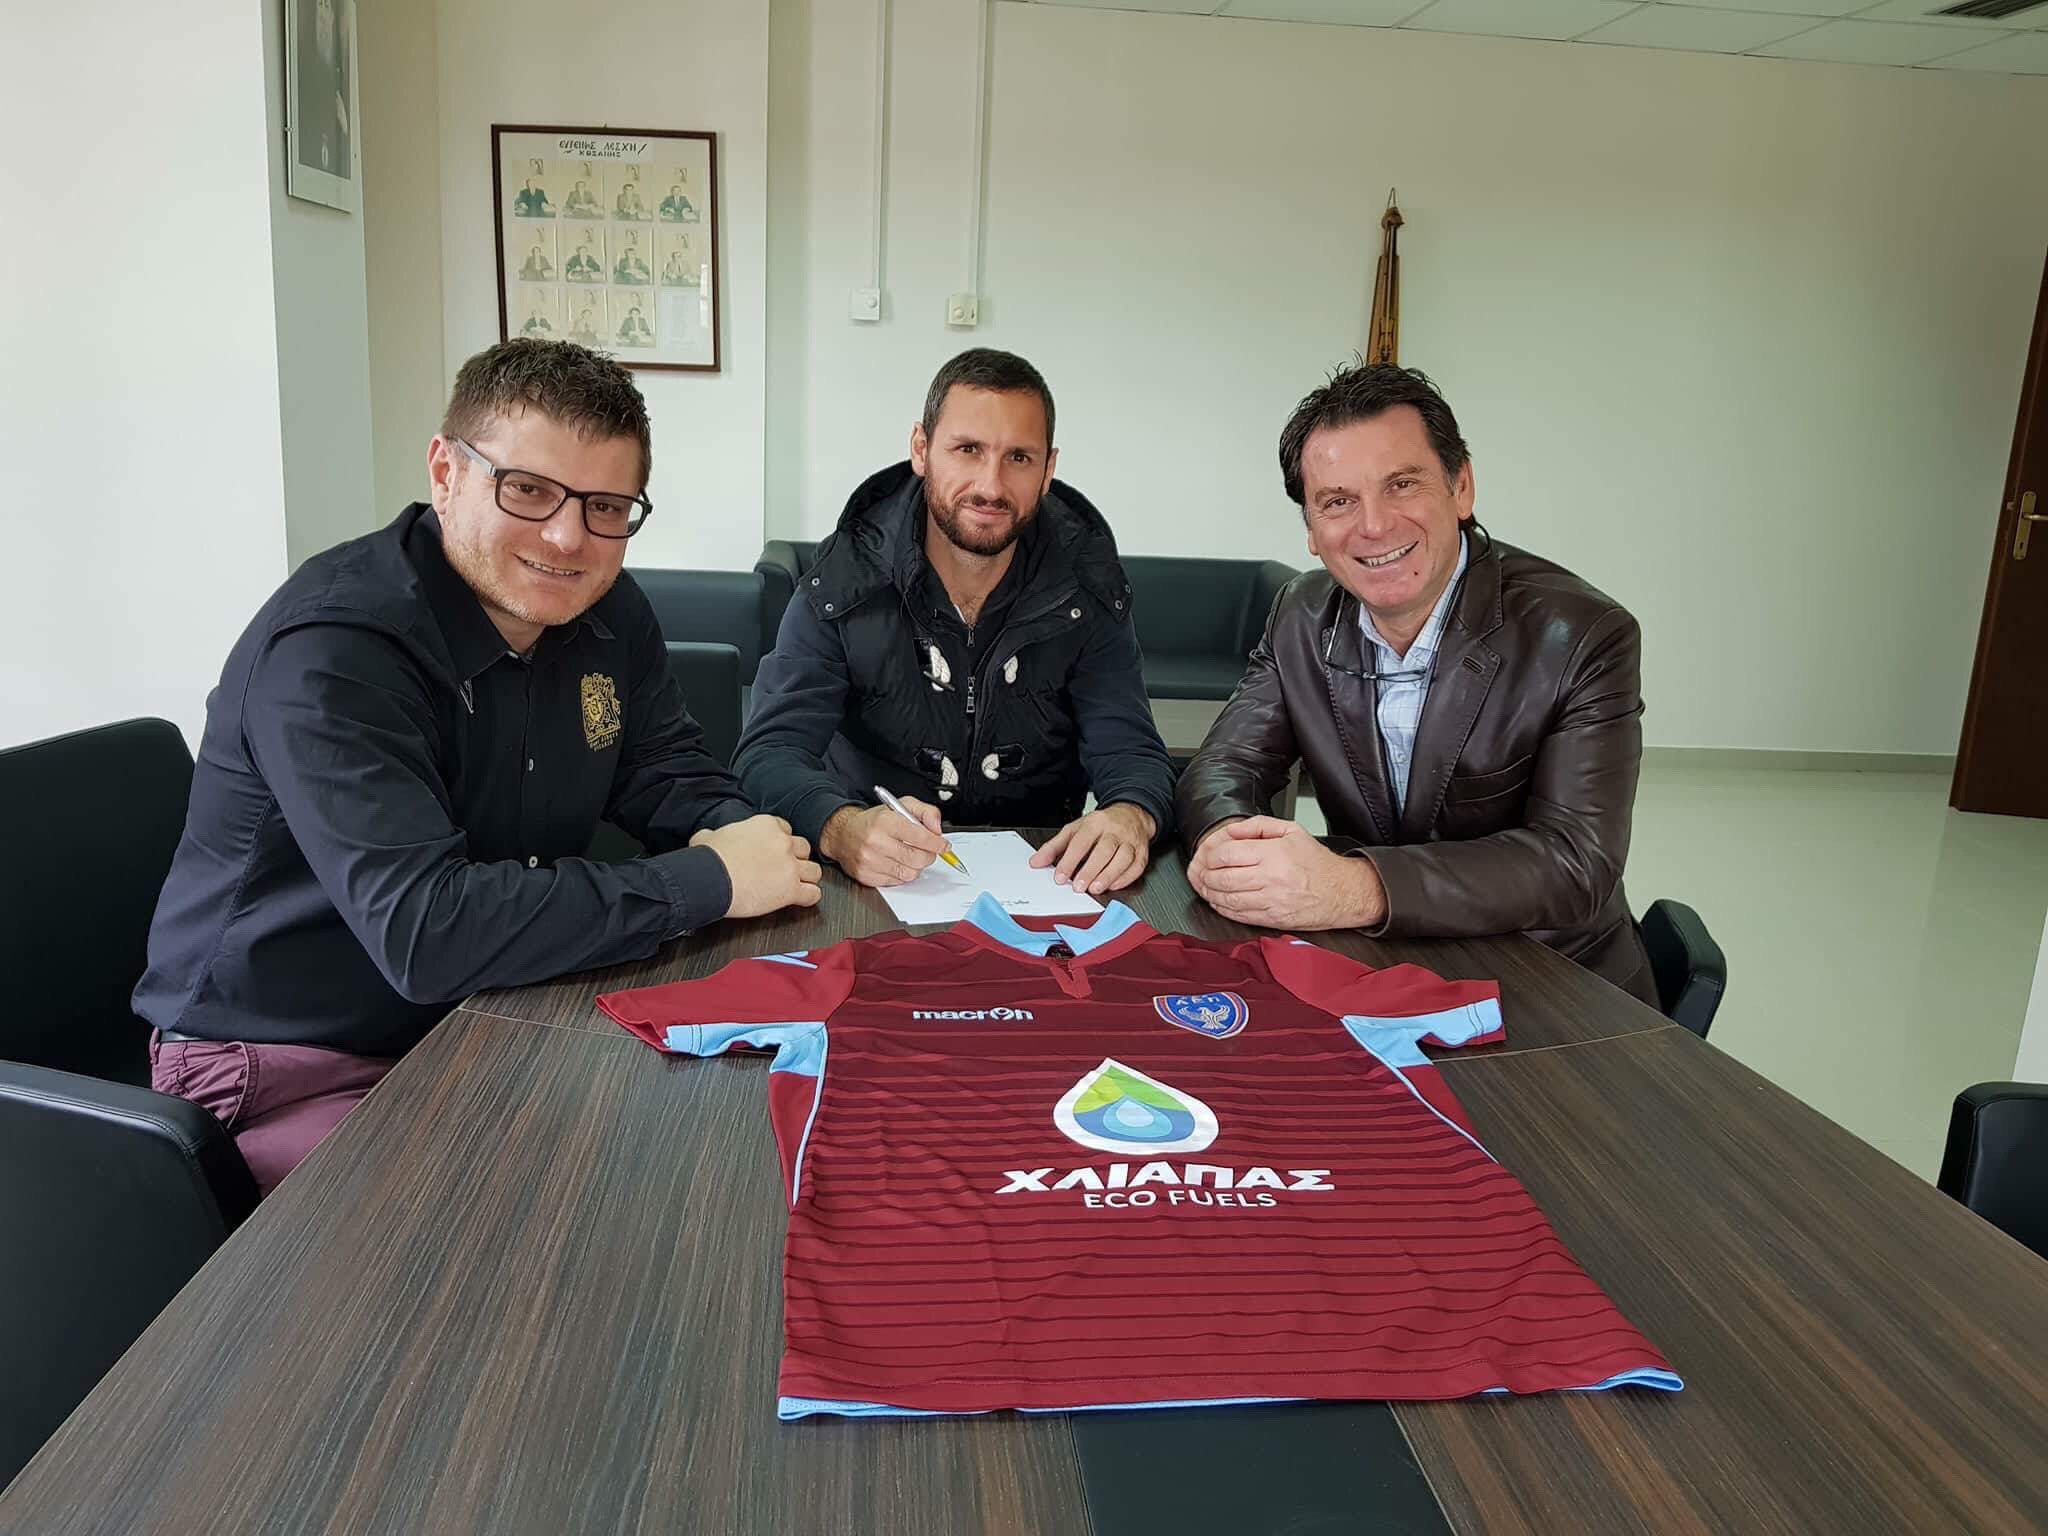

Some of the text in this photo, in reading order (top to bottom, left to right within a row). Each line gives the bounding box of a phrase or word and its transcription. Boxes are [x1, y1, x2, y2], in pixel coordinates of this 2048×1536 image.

[912, 1006, 1034, 1021] macron
[994, 1160, 1336, 1194] ΧΛΙΑΠΑΣ
[1083, 1189, 1278, 1209] ECO FUELS
